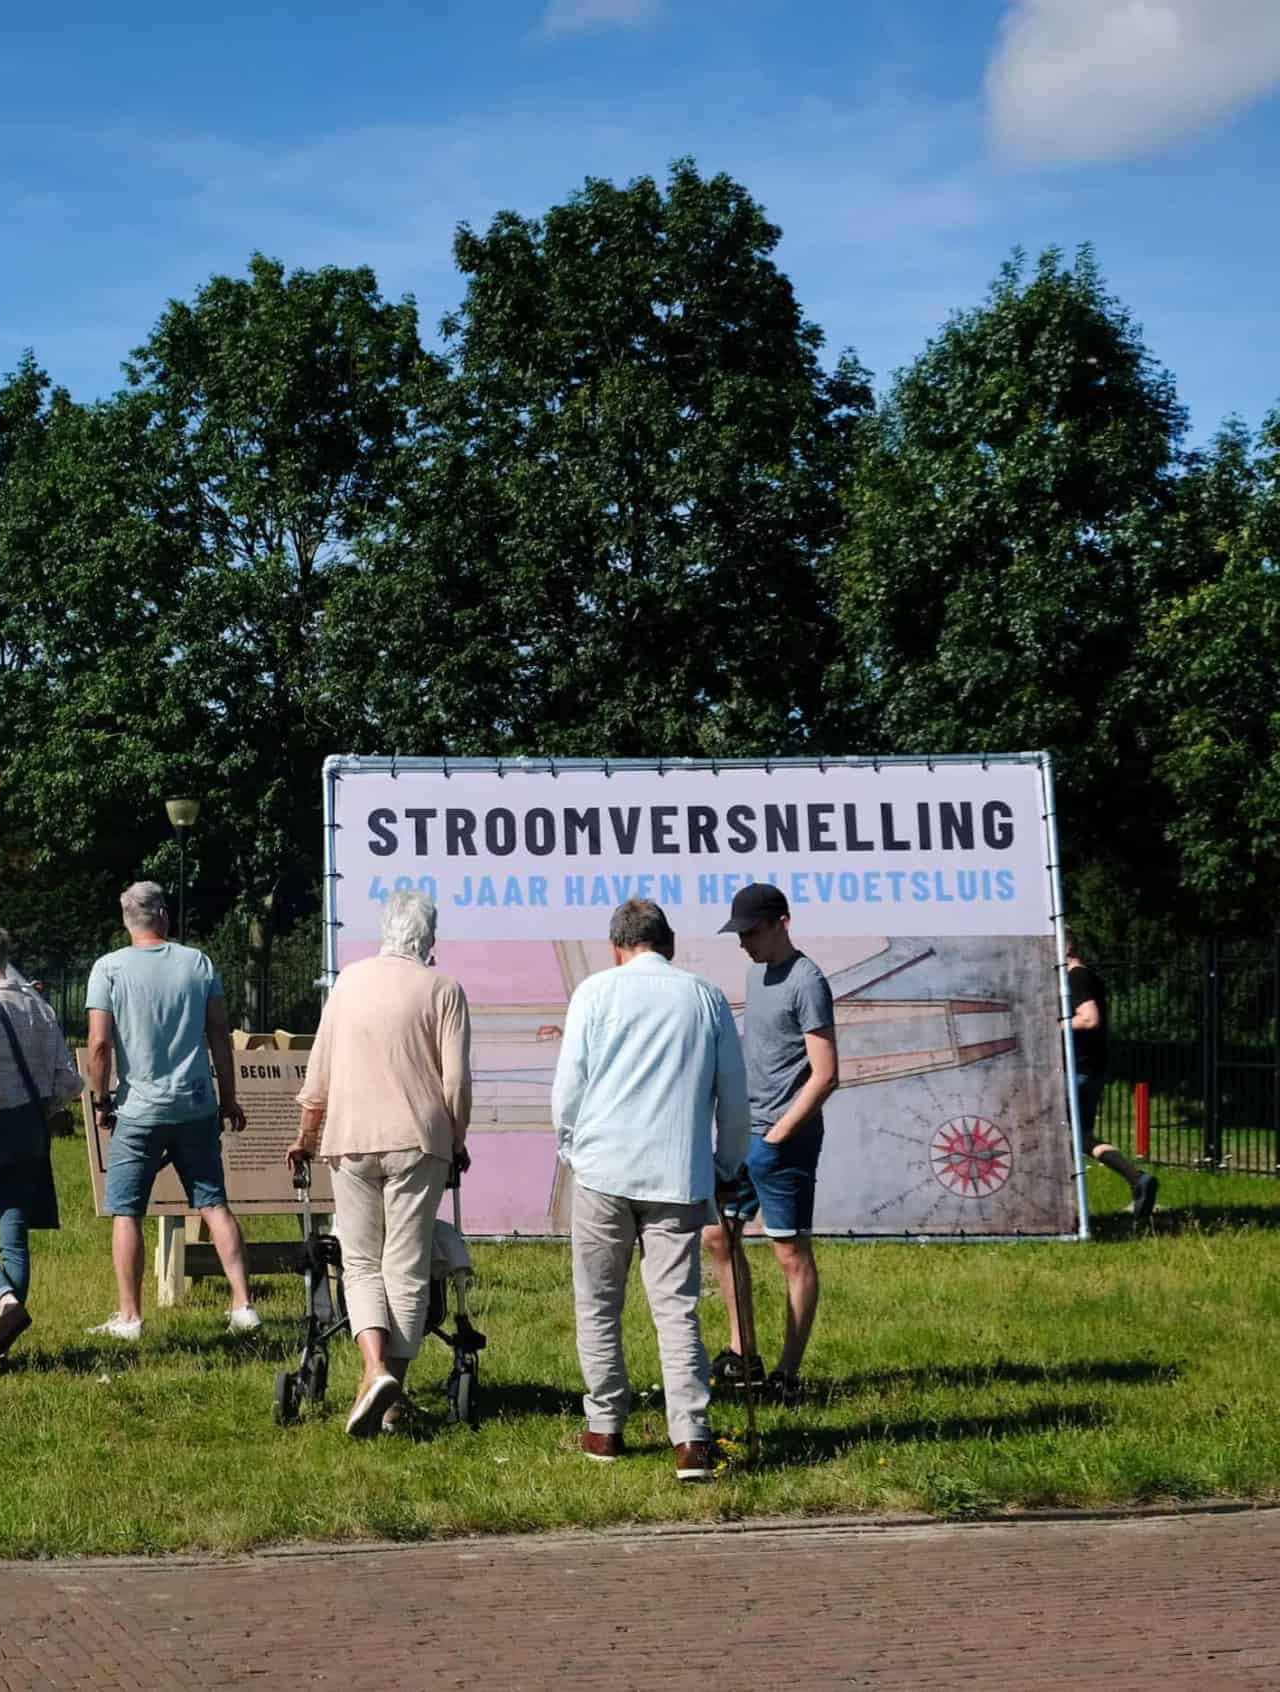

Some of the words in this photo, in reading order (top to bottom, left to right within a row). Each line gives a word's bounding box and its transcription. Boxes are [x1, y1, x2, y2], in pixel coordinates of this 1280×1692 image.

[368, 800, 1014, 856] STROOMVERSNELLING
[453, 875, 548, 907] JAAR
[565, 874, 683, 907] HAVEN
[240, 1065, 281, 1079] BEGIN
